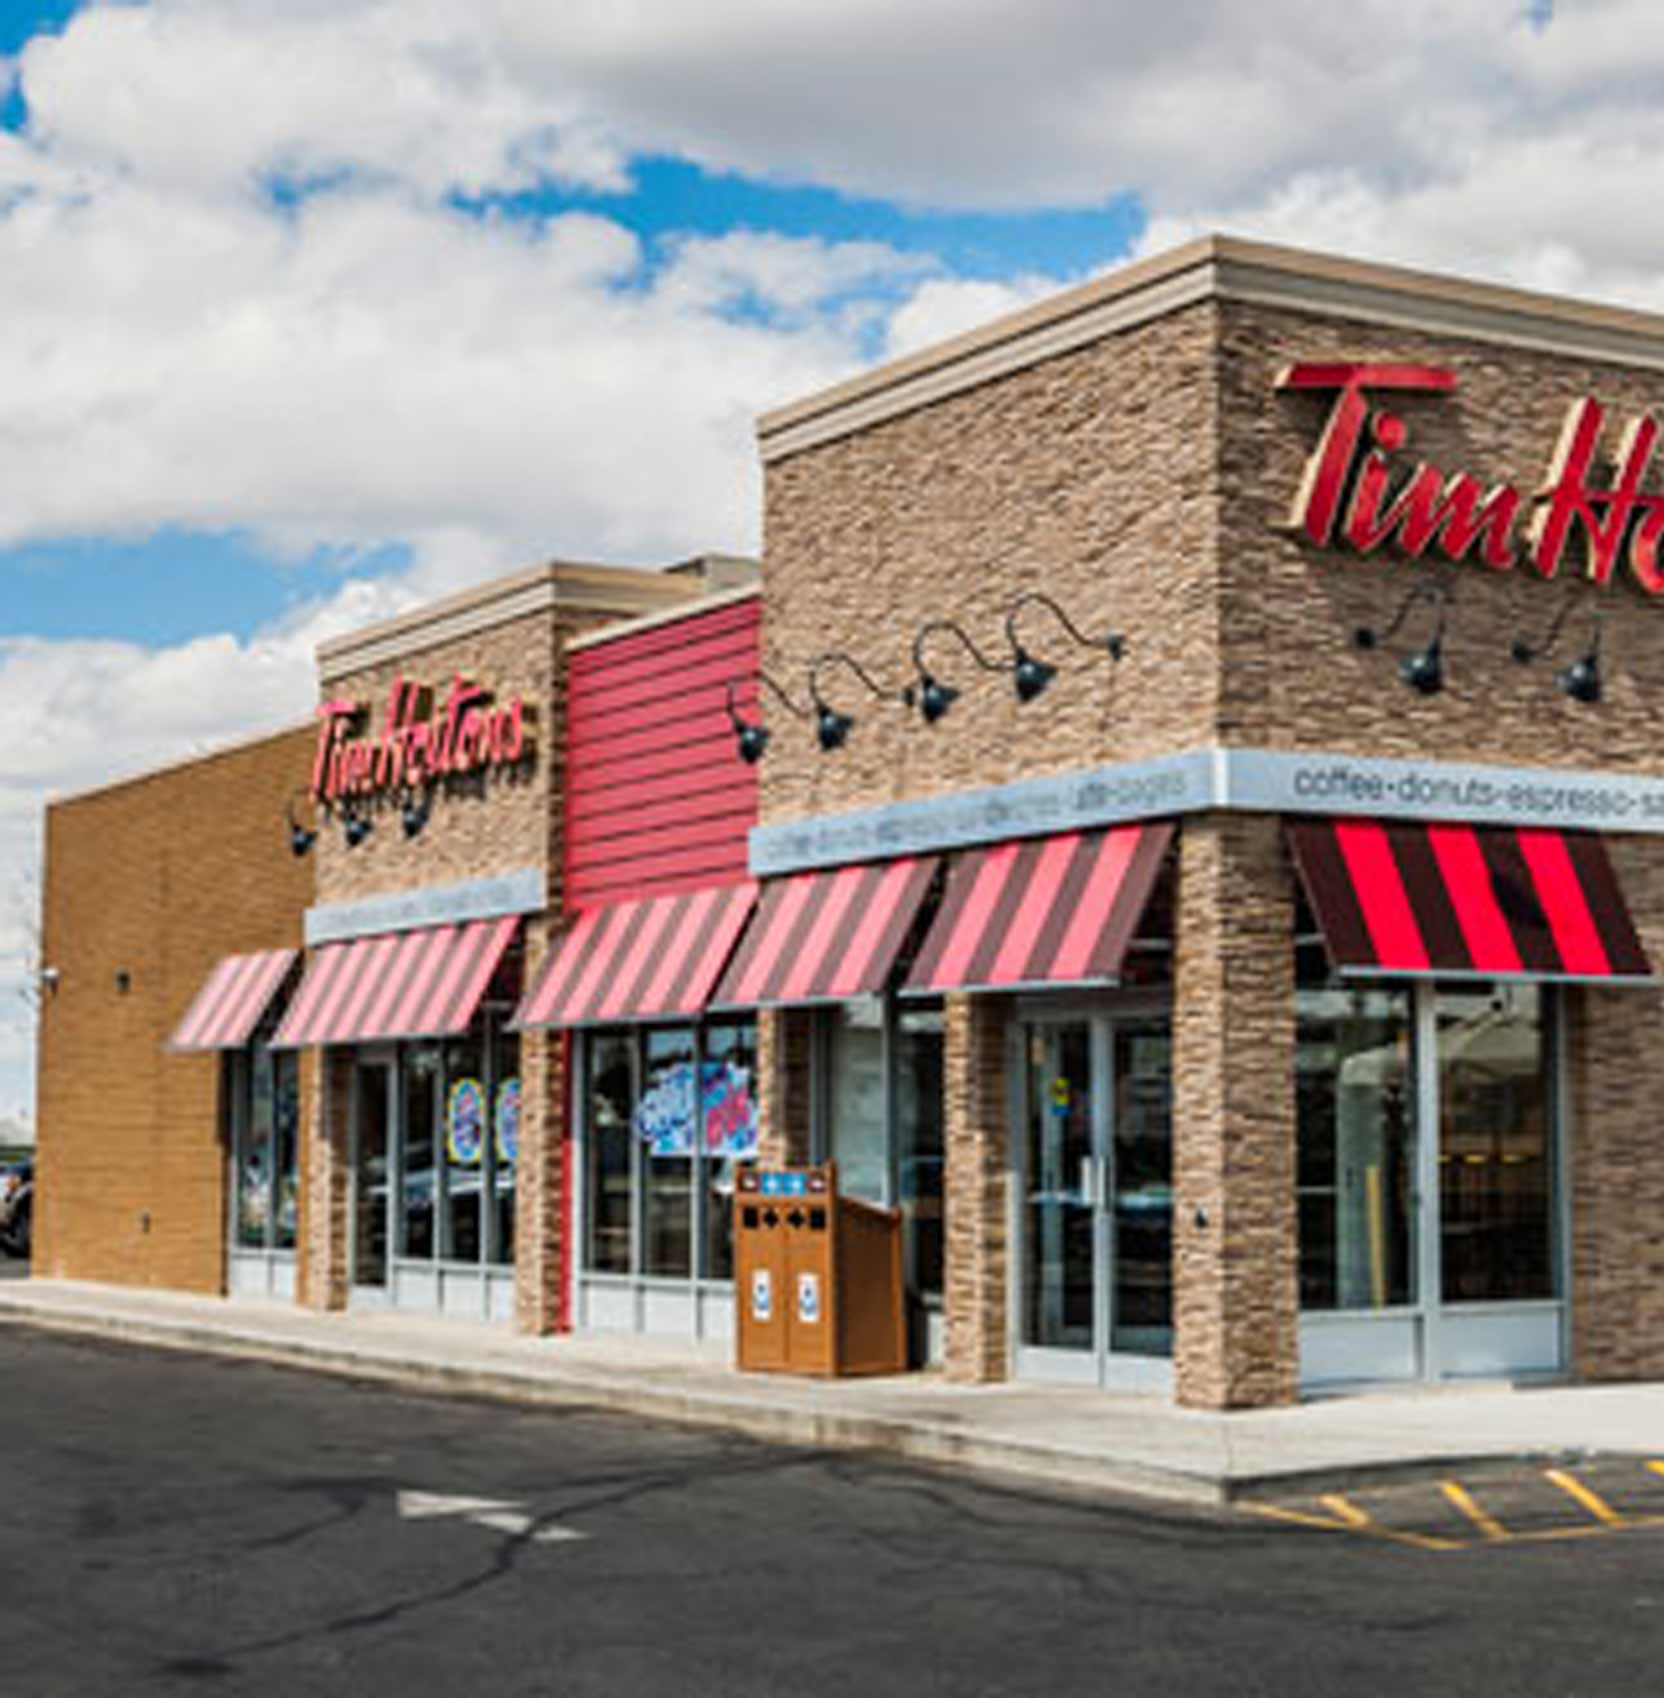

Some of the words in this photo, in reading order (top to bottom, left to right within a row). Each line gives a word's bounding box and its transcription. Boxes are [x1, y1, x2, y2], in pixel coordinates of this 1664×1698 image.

[1275, 362, 1519, 568] Tim
[312, 702, 375, 802] Tim
[376, 672, 522, 785] Hortons
